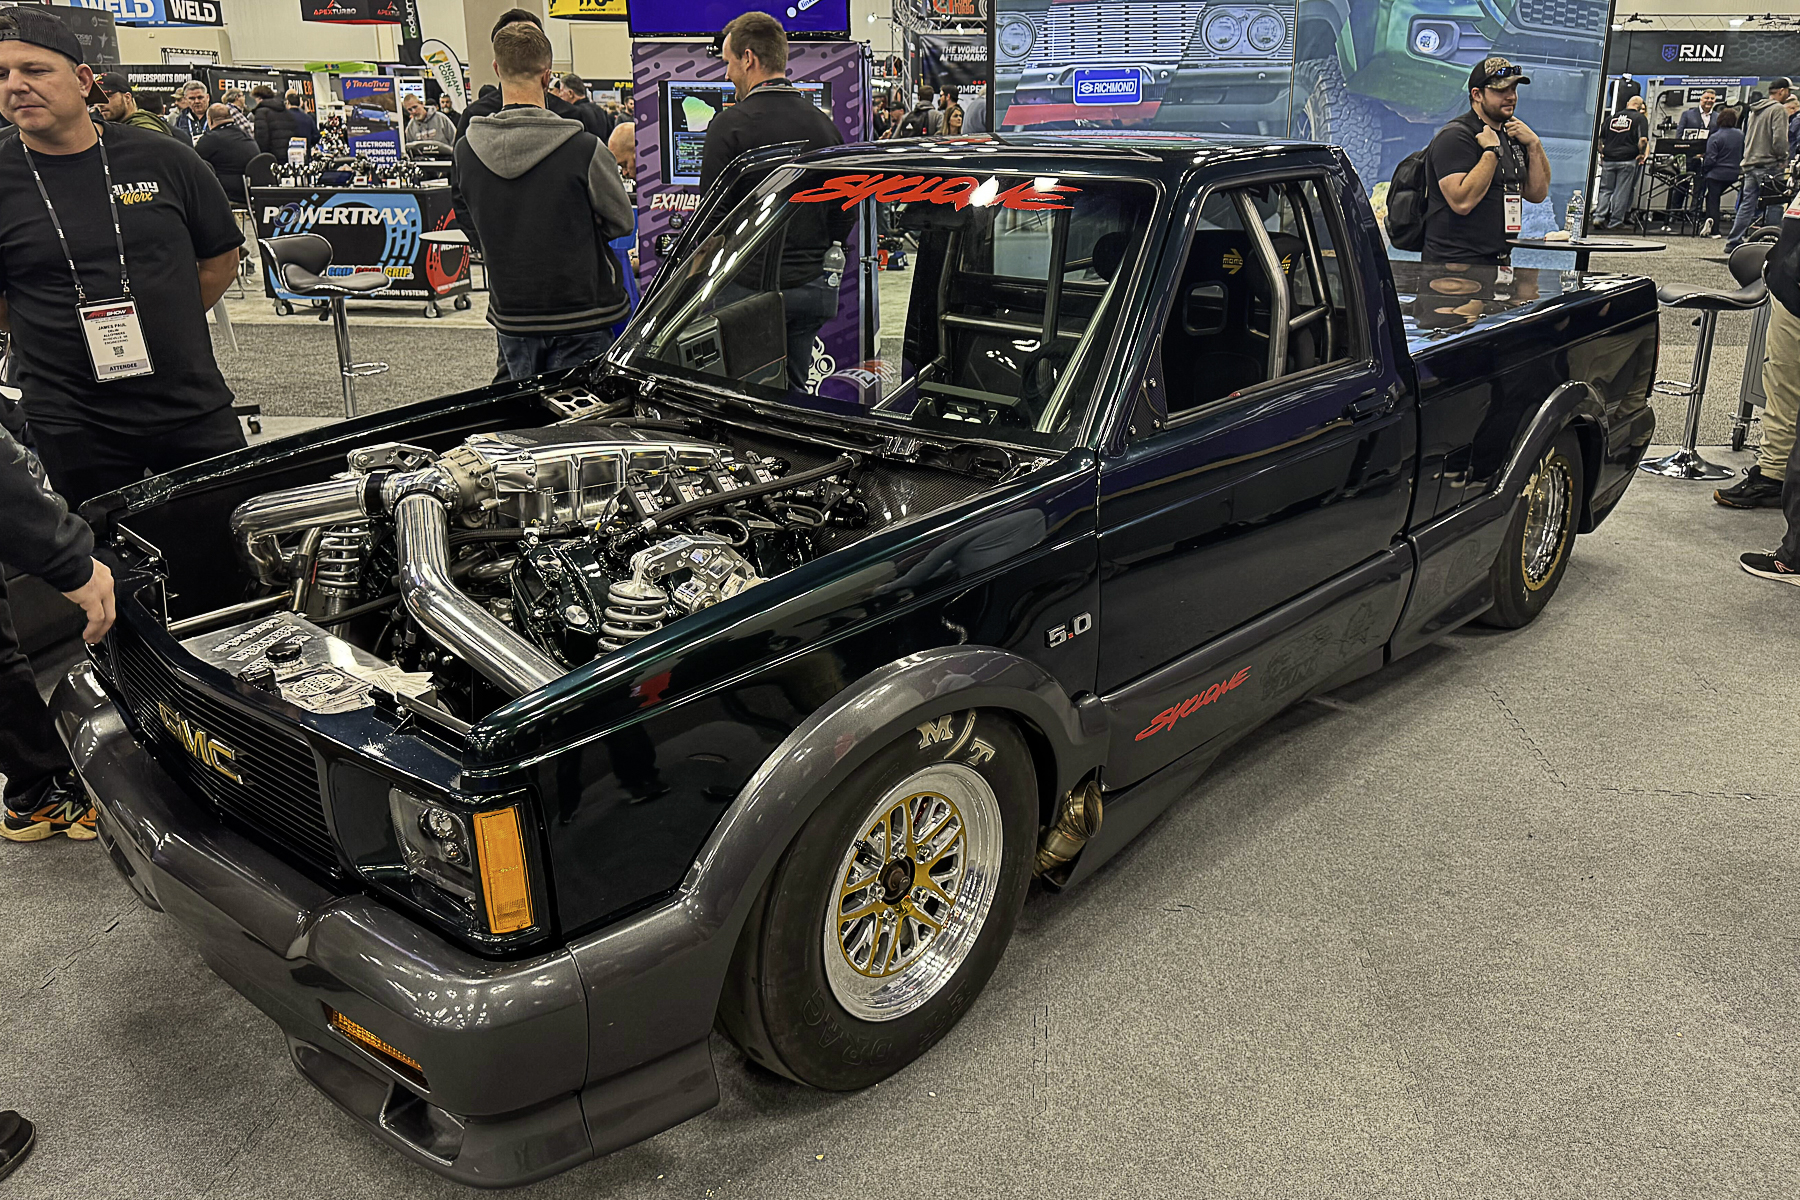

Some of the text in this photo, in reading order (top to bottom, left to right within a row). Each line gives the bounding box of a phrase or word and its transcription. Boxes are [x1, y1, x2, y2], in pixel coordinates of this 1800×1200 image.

[80, 0, 155, 18] WELD
[169, 0, 217, 22] WELD
[1679, 44, 1725, 58] RINI
[128, 73, 173, 83] POWERSPORTS
[438, 64, 452, 88] CORN
[444, 61, 463, 97] INDIANA
[1094, 81, 1135, 93] RICHMOND
[120, 190, 153, 206] Werx
[263, 203, 410, 228] POWERTRAX
[328, 266, 354, 278] GRIP
[385, 267, 412, 279] GRIP
[401, 289, 429, 297] SYSTEMS
[109, 362, 138, 372] ATTENDEE
[1046, 611, 1092, 649] 5.0
[1135, 665, 1252, 742] SYCLONE
[158, 701, 244, 785] GMC
